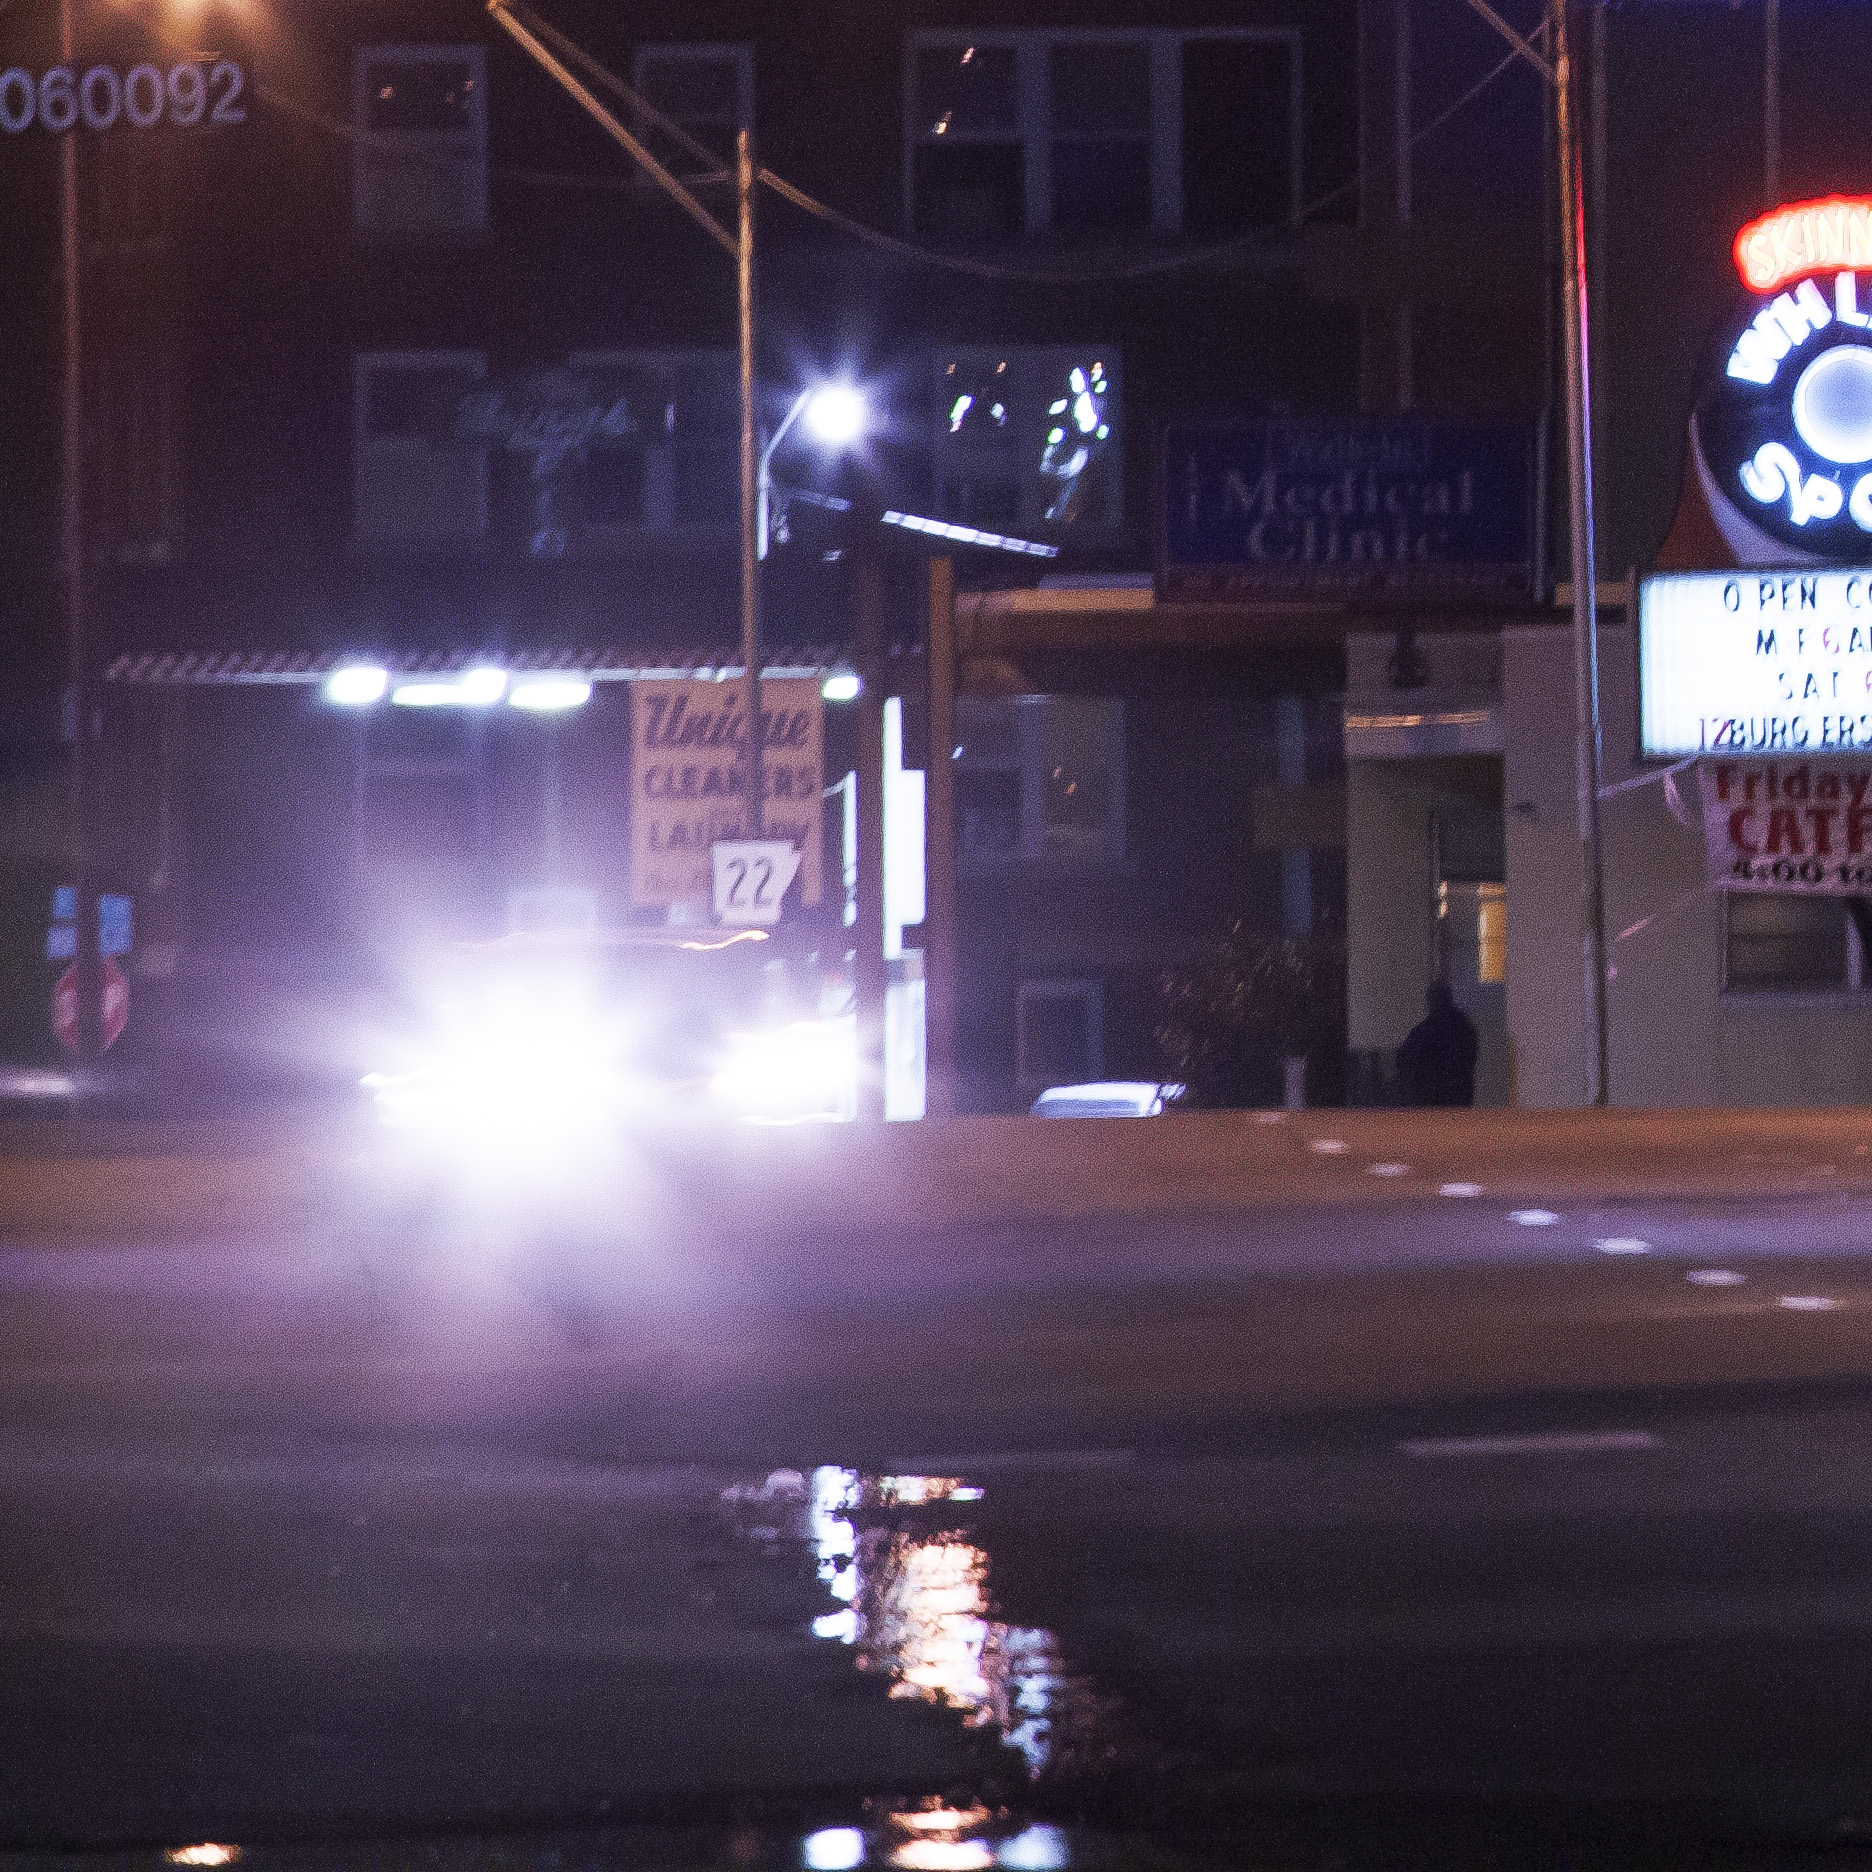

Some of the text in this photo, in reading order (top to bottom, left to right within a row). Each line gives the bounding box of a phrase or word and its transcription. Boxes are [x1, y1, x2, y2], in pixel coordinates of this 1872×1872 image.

[0, 63, 247, 133] 060092
[1223, 469, 1476, 516] Medical
[1247, 515, 1449, 563] Clinic
[645, 693, 811, 761] Unique
[1715, 761, 1869, 811] Friday
[726, 856, 774, 908] 22
[1733, 858, 1825, 885] 4:00
